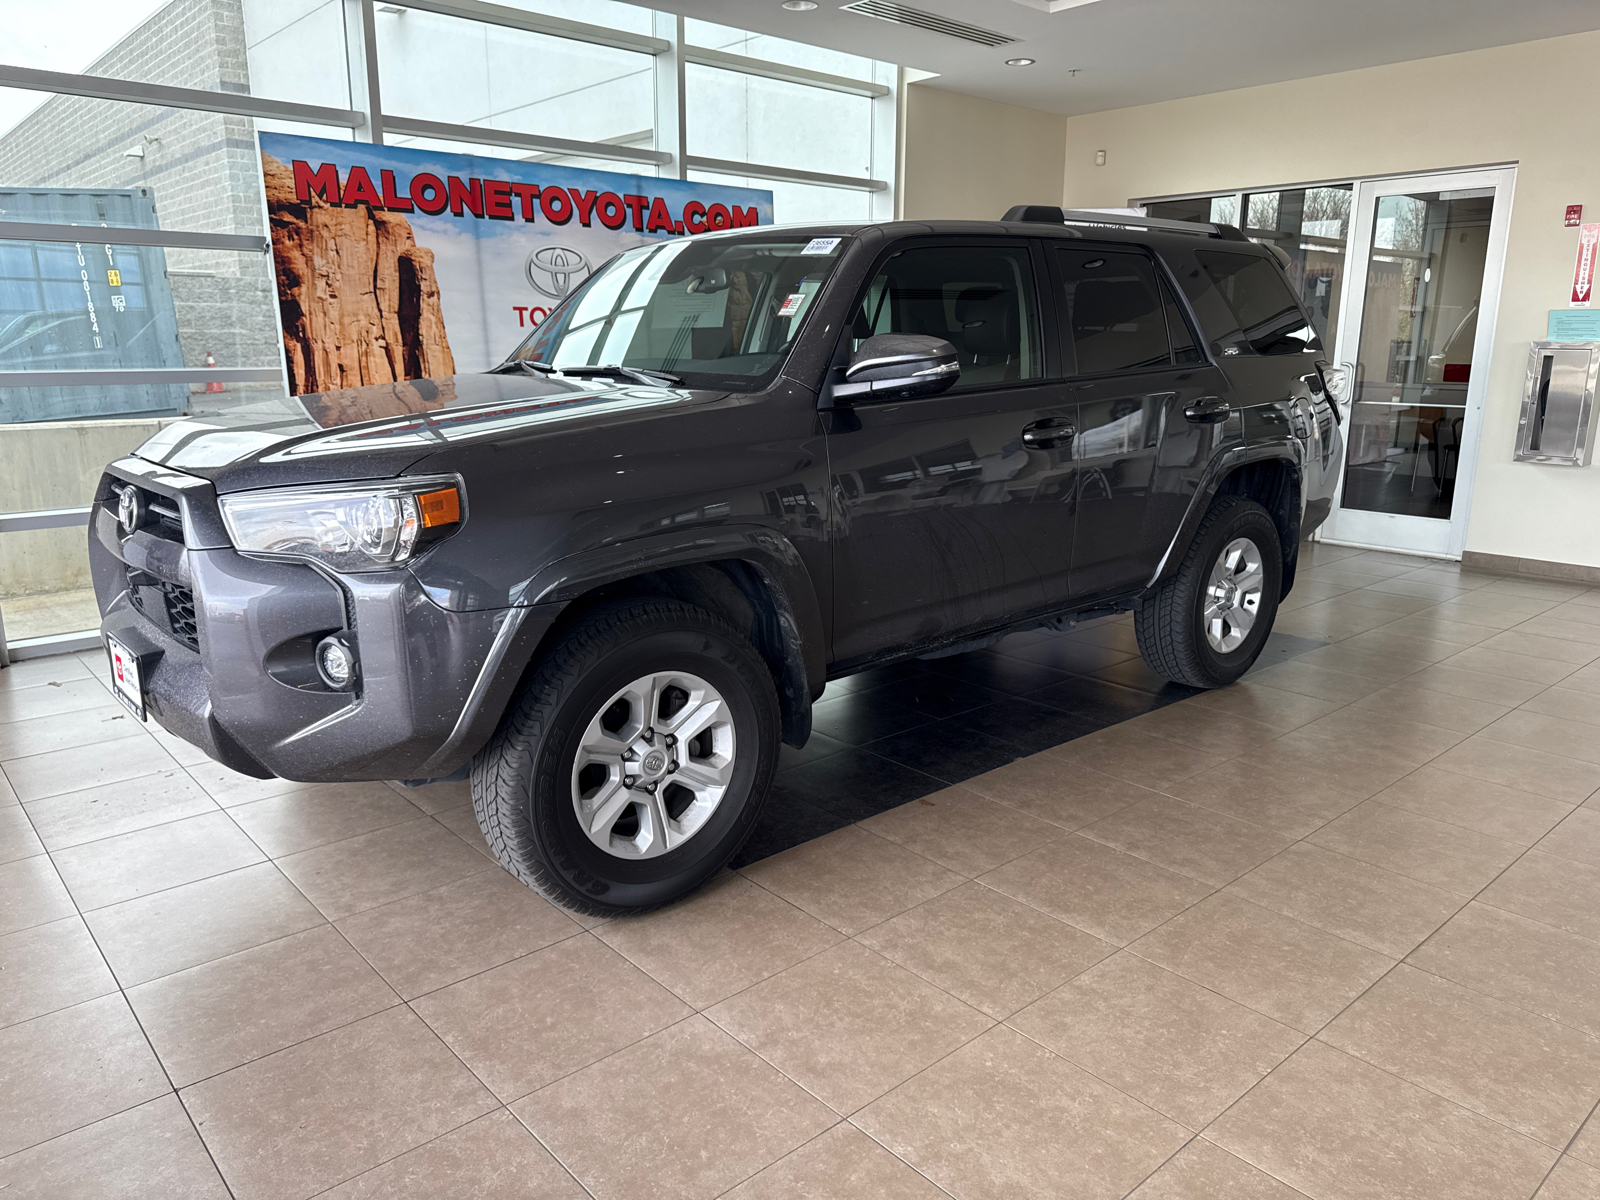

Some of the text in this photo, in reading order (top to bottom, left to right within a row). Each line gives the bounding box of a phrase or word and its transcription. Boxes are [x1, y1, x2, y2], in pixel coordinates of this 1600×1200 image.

[292, 159, 760, 235] MALONETOYOTA.COM
[1579, 239, 1591, 295] EXTINGUISHER
[539, 726, 612, 896] GRANDTREK
